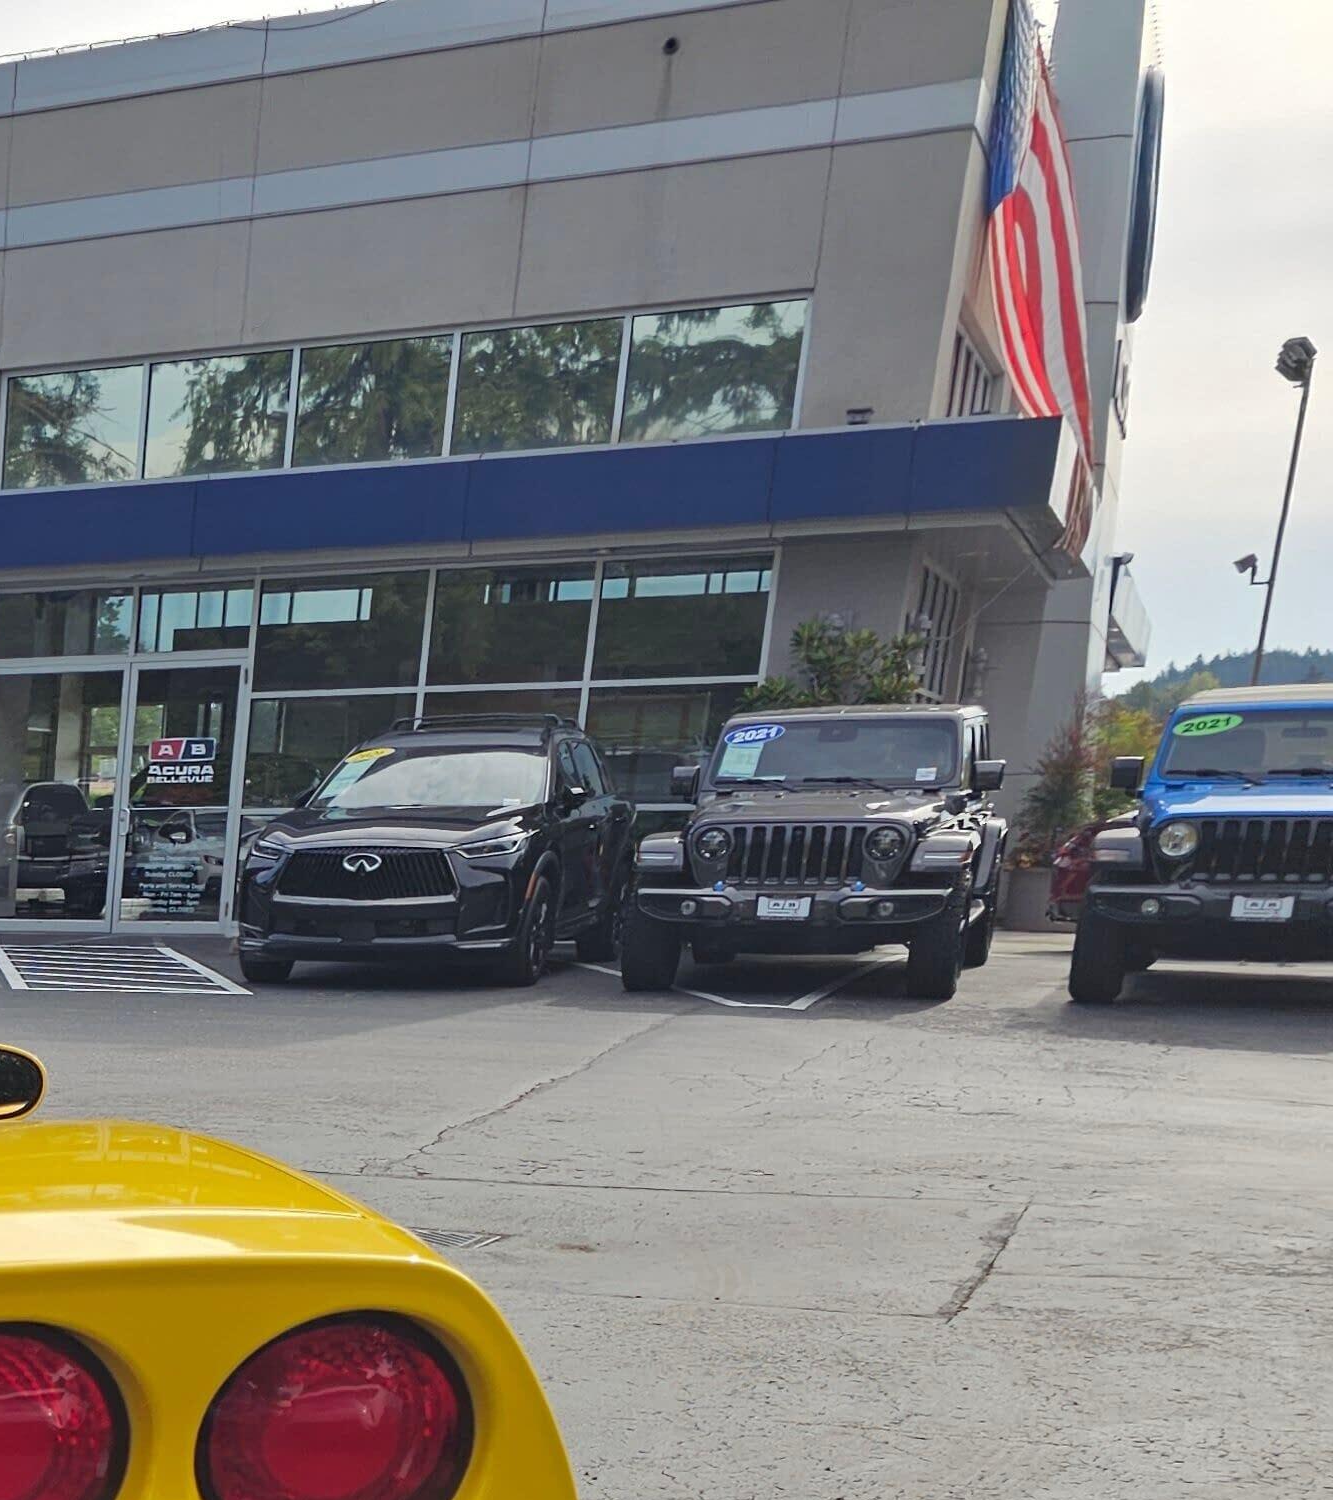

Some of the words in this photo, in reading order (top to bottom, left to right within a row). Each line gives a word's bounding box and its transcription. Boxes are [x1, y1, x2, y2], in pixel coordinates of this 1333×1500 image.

[1181, 716, 1231, 734] 2021
[732, 727, 778, 743] 2021
[148, 765, 214, 775] ACURA
